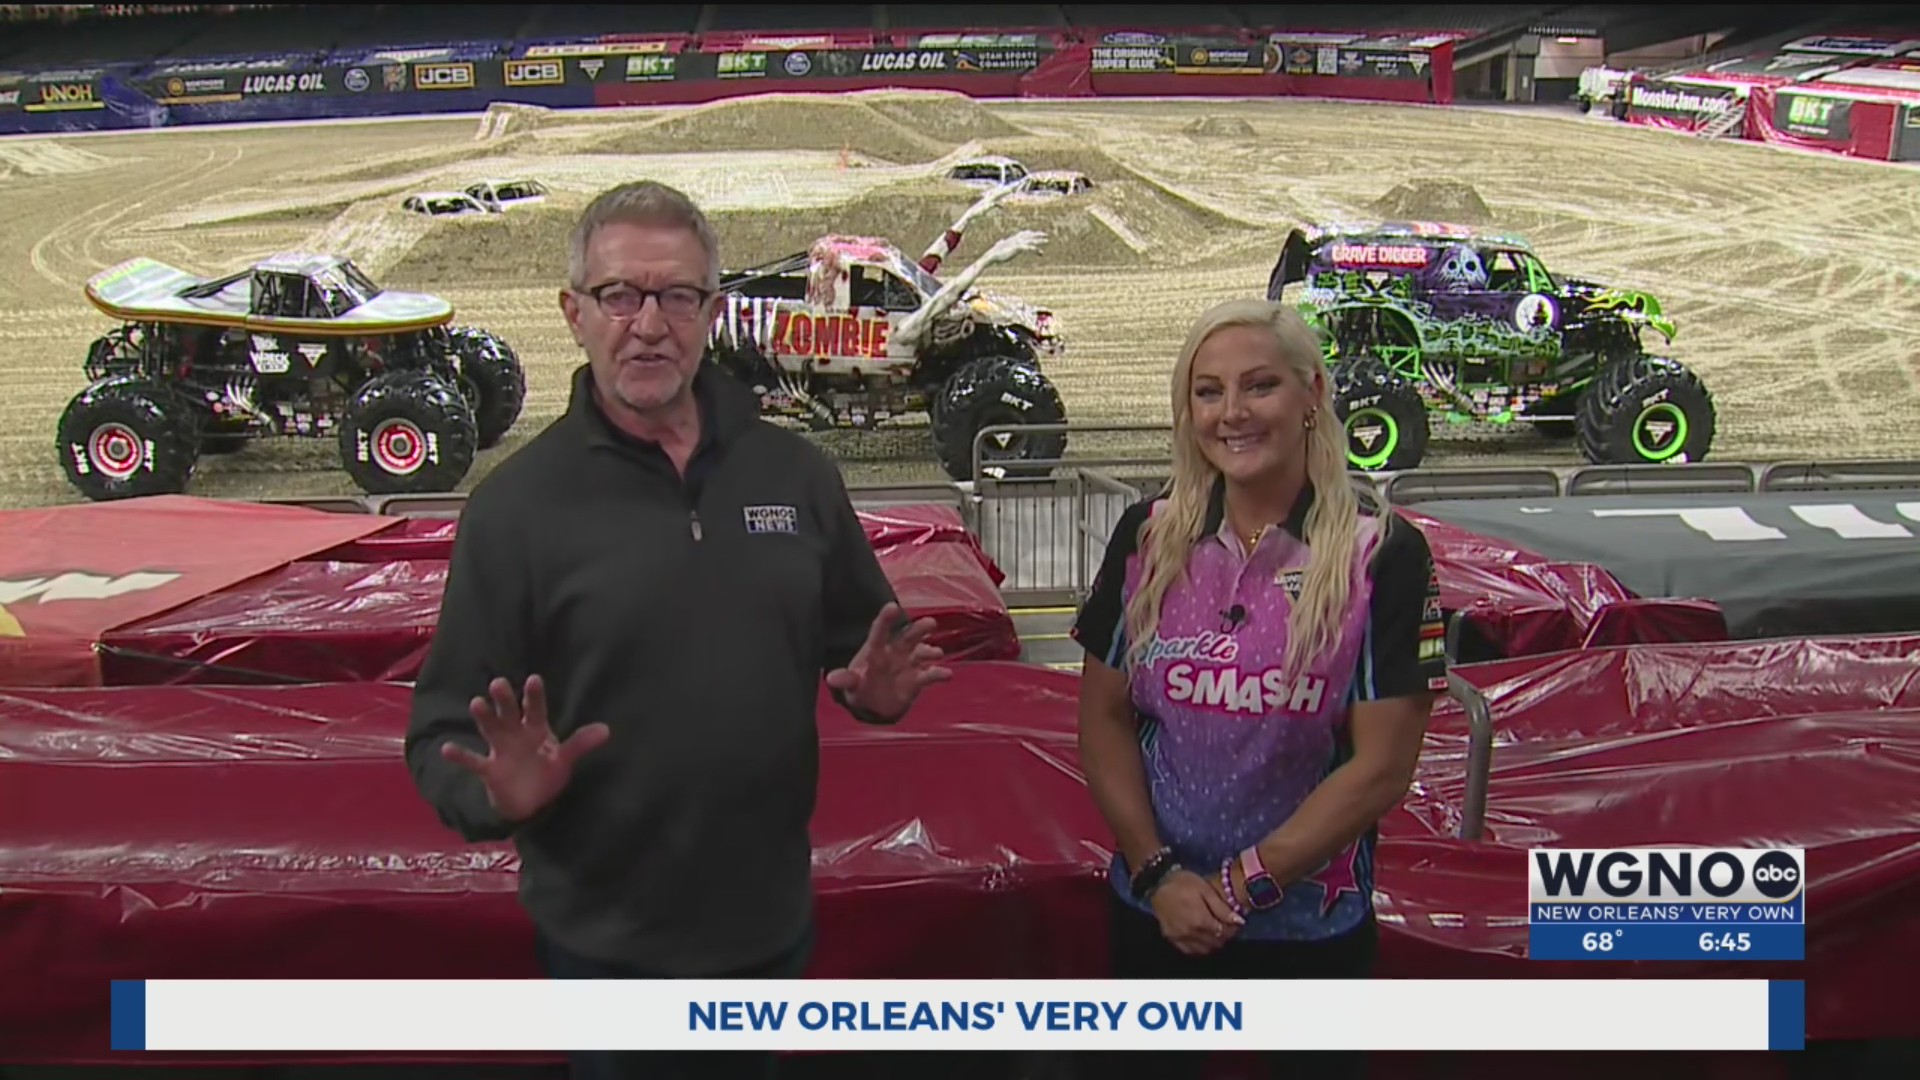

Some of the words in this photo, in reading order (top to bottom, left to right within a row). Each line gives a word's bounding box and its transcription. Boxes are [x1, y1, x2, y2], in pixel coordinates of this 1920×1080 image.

[718, 51, 766, 72] BKT
[862, 52, 917, 70] LUCAS
[918, 51, 945, 69] OIL
[1004, 51, 1036, 60] SPORTS
[1091, 48, 1111, 58] THE
[1113, 48, 1159, 58] ORIGINAL
[509, 64, 557, 81] JCB
[626, 56, 672, 76] BKT
[1091, 58, 1126, 69] SUPER
[1129, 59, 1155, 69] GLUE
[243, 75, 295, 93] LUCAS
[297, 74, 324, 90] OIL
[420, 68, 468, 83] JCB
[41, 84, 92, 101] UNOH
[1632, 86, 1727, 114] MonsterJam.com
[1788, 96, 1834, 125] BKT
[1332, 244, 1377, 263] GRAVE
[1378, 245, 1427, 263] DIGGER
[772, 310, 889, 357] ZOMBIE
[1165, 662, 1327, 715] SMASH
